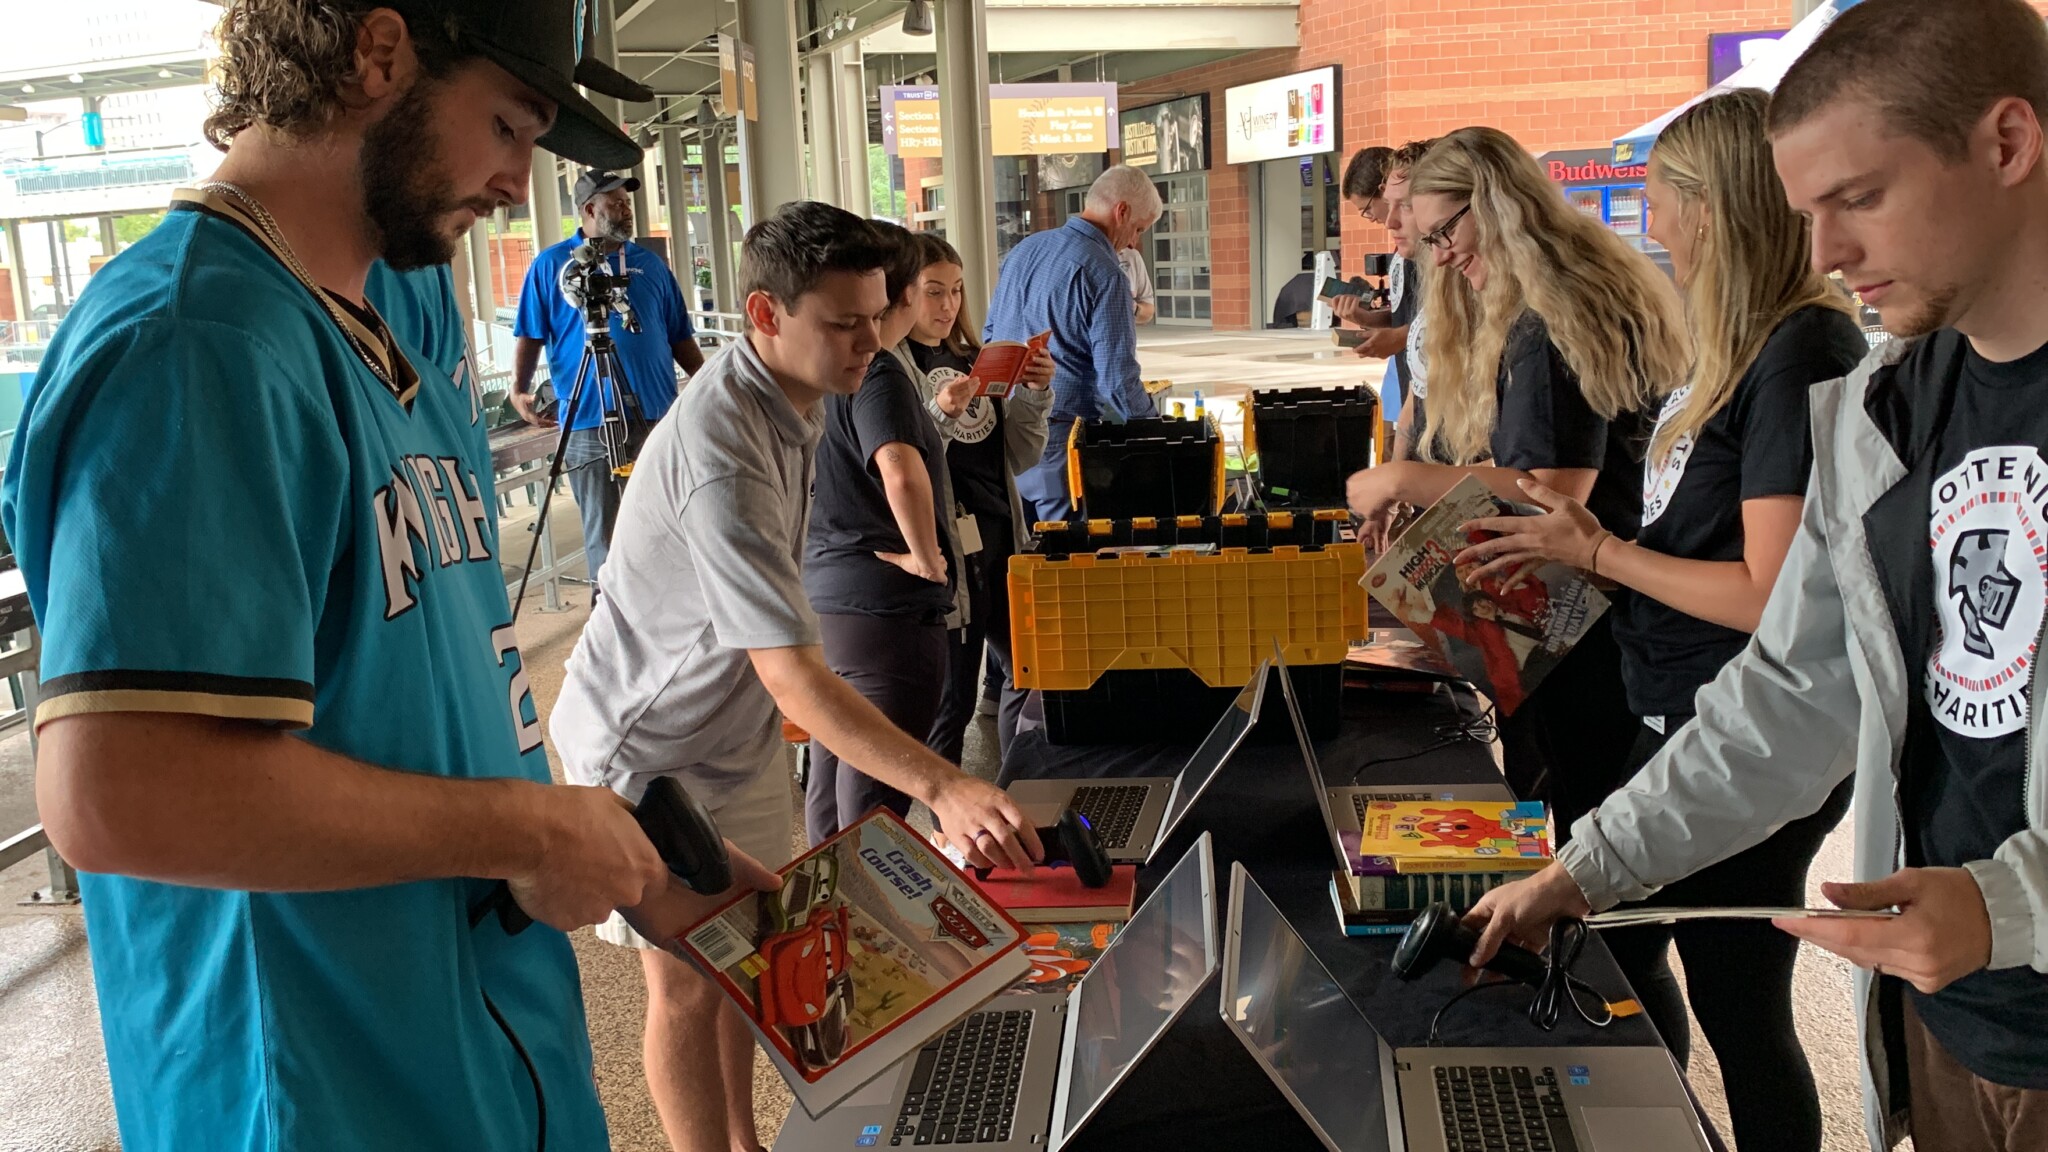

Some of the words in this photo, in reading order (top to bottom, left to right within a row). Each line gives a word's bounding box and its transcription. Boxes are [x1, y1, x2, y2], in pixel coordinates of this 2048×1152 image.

[899, 111, 933, 120] Section
[1050, 120, 1069, 131] Play
[1070, 120, 1093, 130] Zone
[1548, 160, 1648, 181] Budweis
[954, 419, 994, 440] HARITIES
[1399, 546, 1430, 579] HIGH
[1425, 539, 1451, 564] 3
[1408, 555, 1435, 583] SCHOOL
[1415, 561, 1445, 592] MUSICAL
[1546, 579, 1582, 652] GRADUATION
[859, 847, 923, 900] Course!
[886, 850, 933, 892] Crash
[936, 902, 978, 942] Cars
